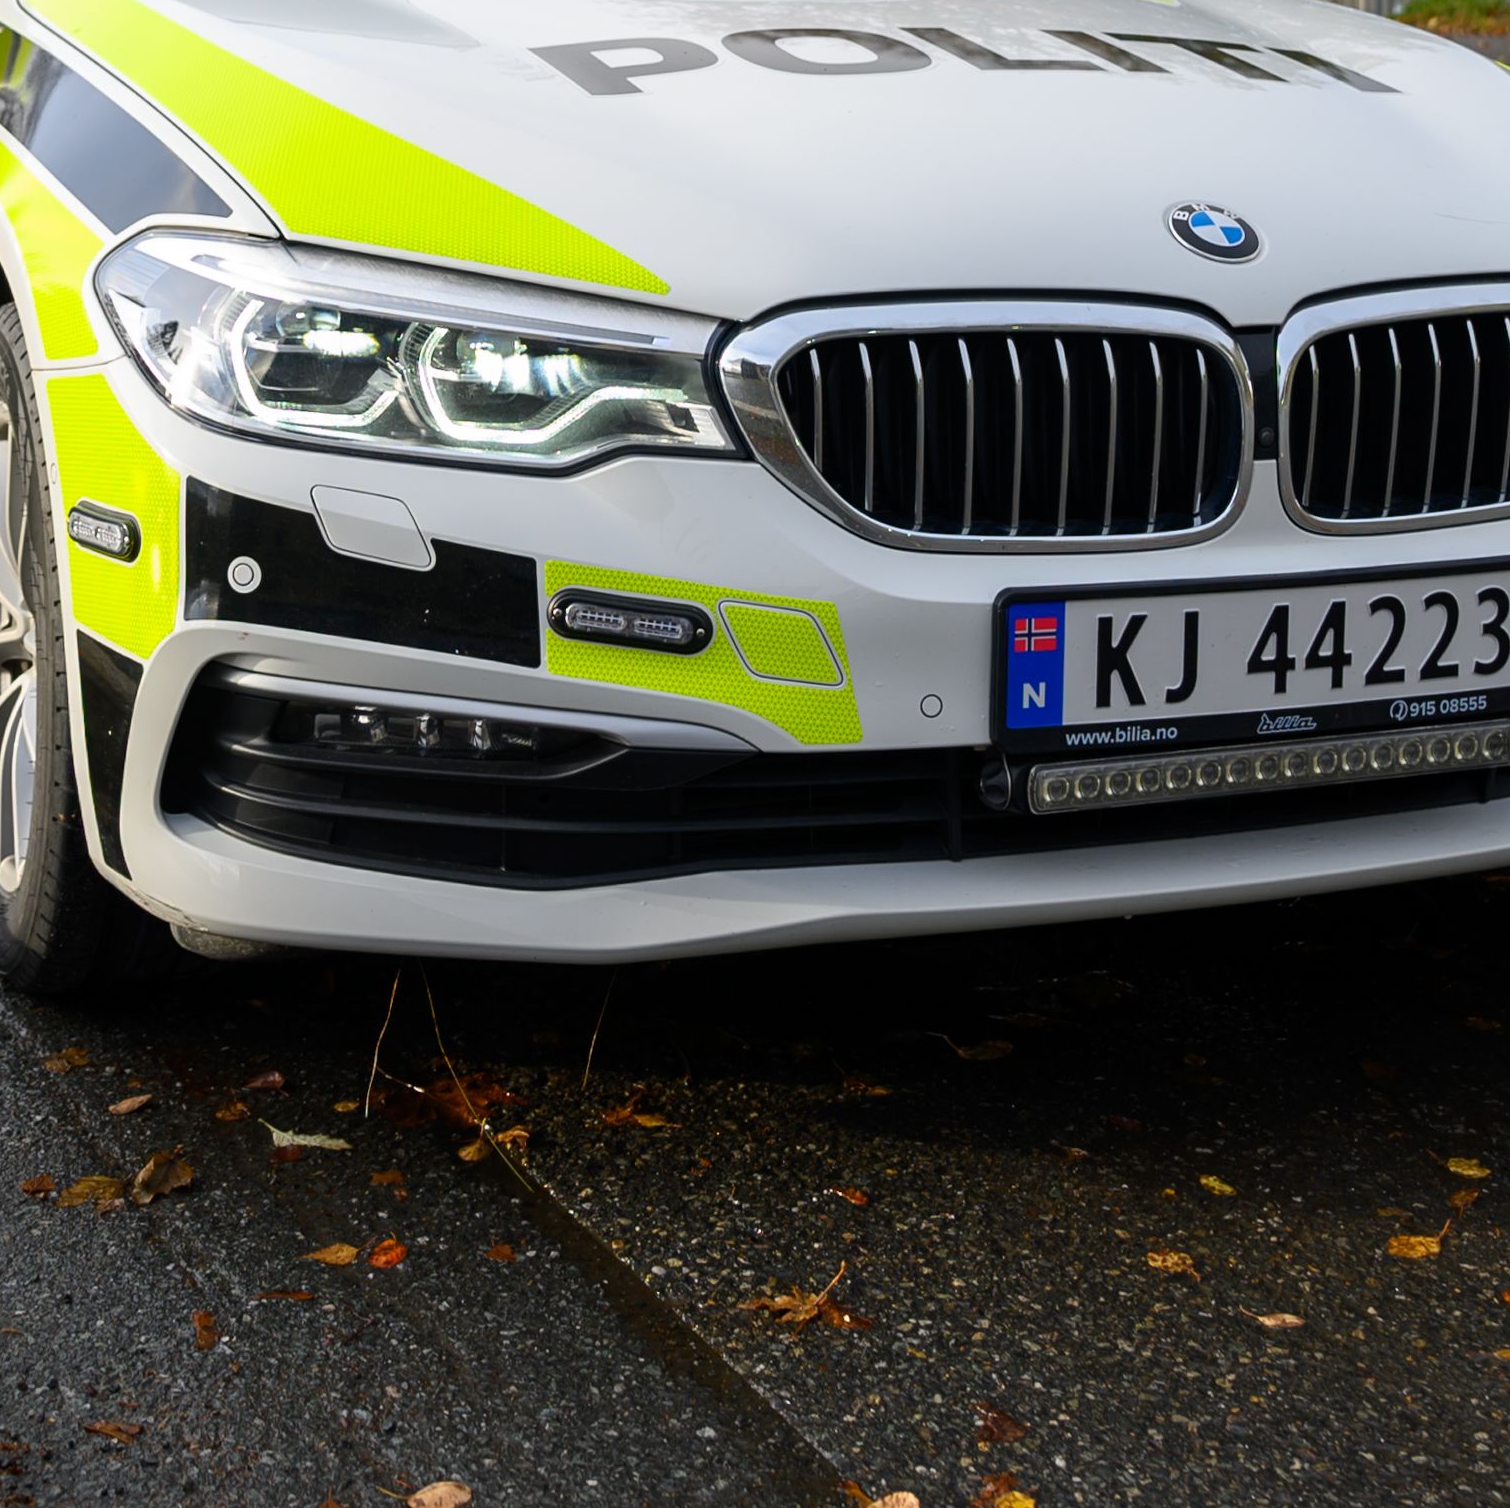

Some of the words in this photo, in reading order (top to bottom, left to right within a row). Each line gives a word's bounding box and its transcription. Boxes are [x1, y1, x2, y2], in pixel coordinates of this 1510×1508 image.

[528, 26, 1403, 97] POLITI
[1094, 609, 1200, 709] KJ
[1022, 682, 1046, 710] N
[1409, 700, 1436, 717] 915
[1439, 695, 1489, 714] 08555
[1065, 725, 1179, 746] www.bilia.no
